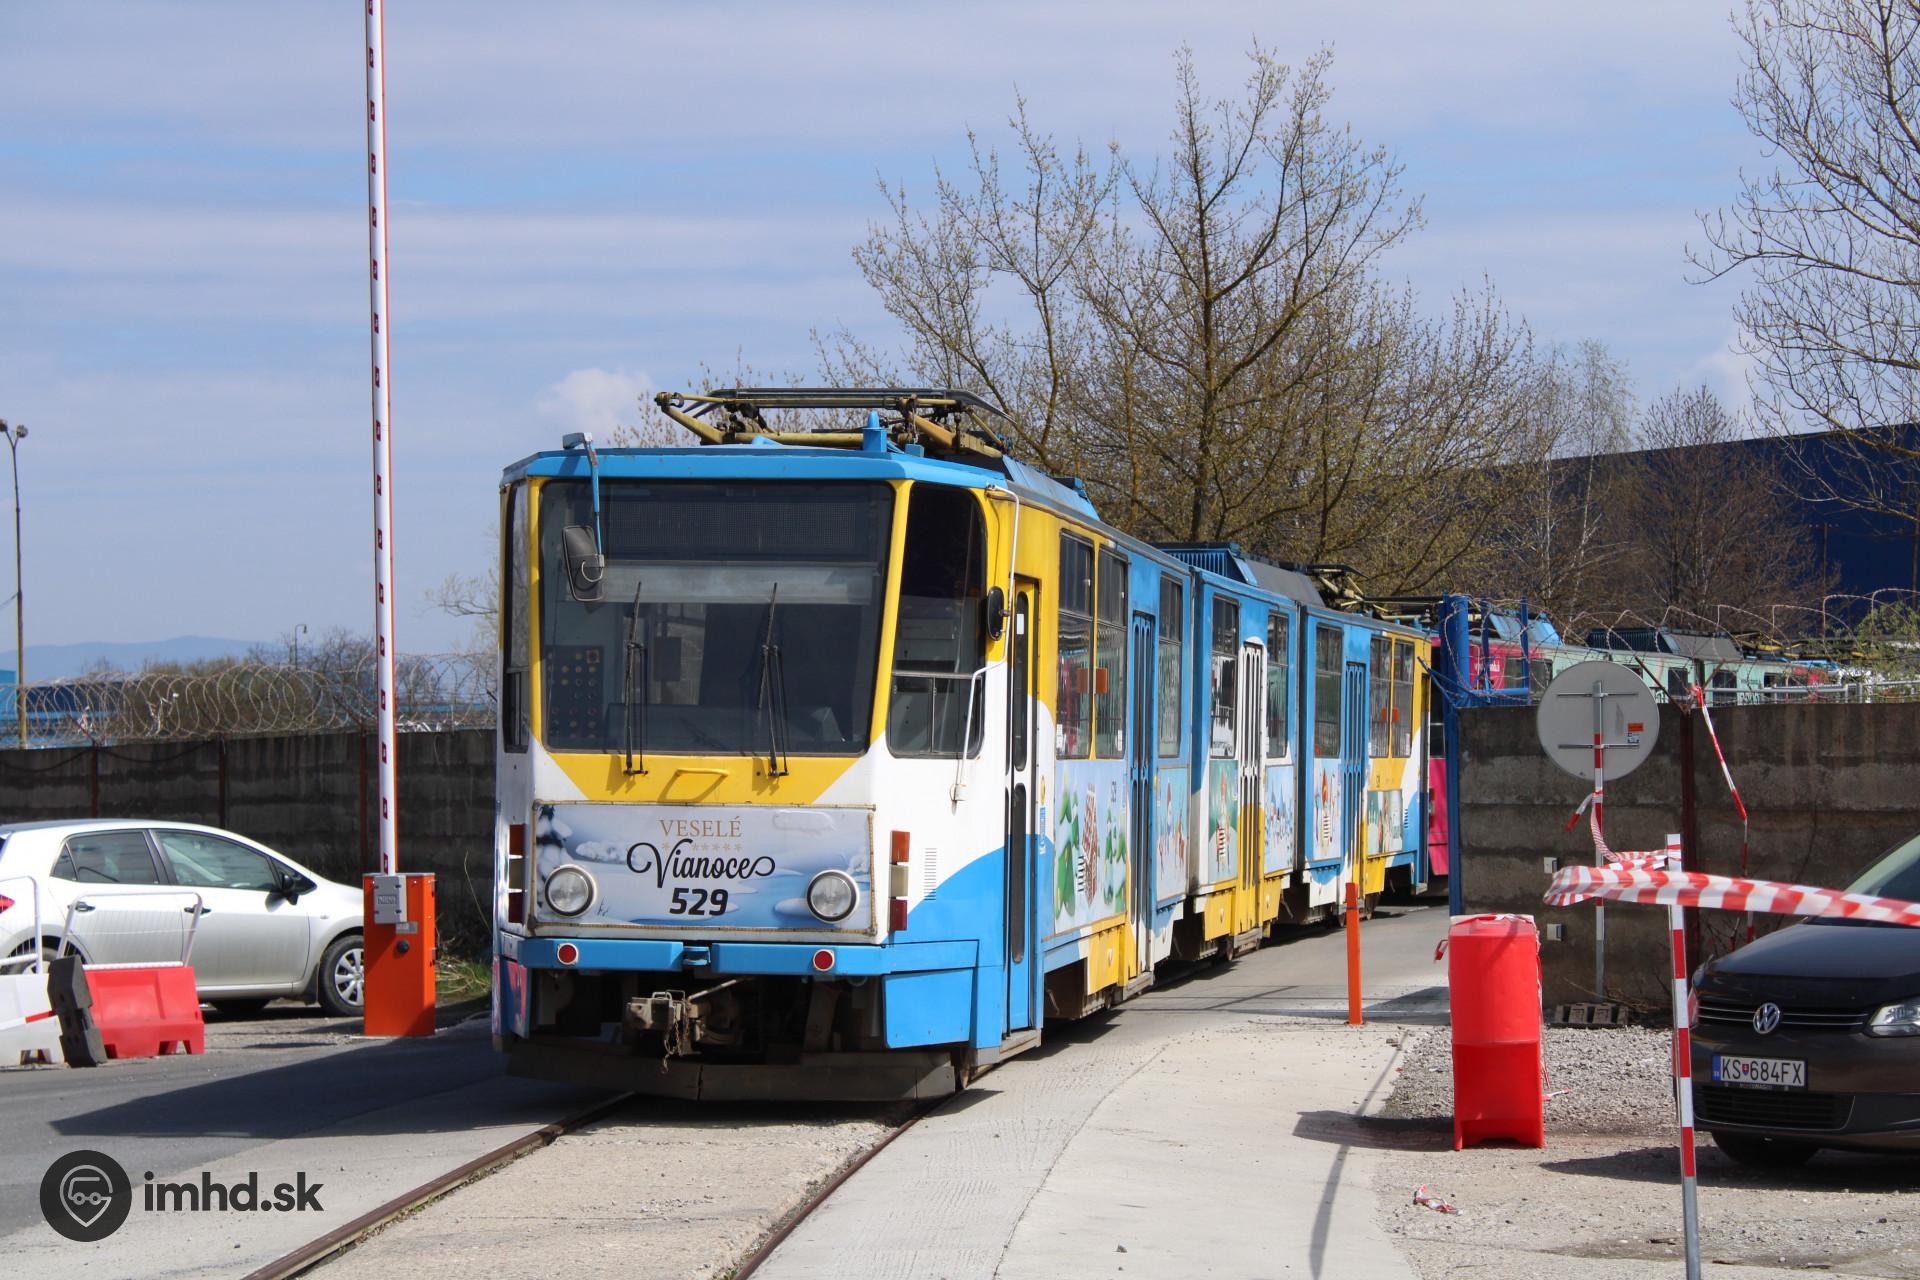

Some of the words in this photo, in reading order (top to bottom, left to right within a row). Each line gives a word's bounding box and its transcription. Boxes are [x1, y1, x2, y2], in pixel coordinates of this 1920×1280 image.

[660, 815, 743, 838] VESELÉ
[626, 838, 776, 888] Vianoce
[669, 887, 729, 916] 529
